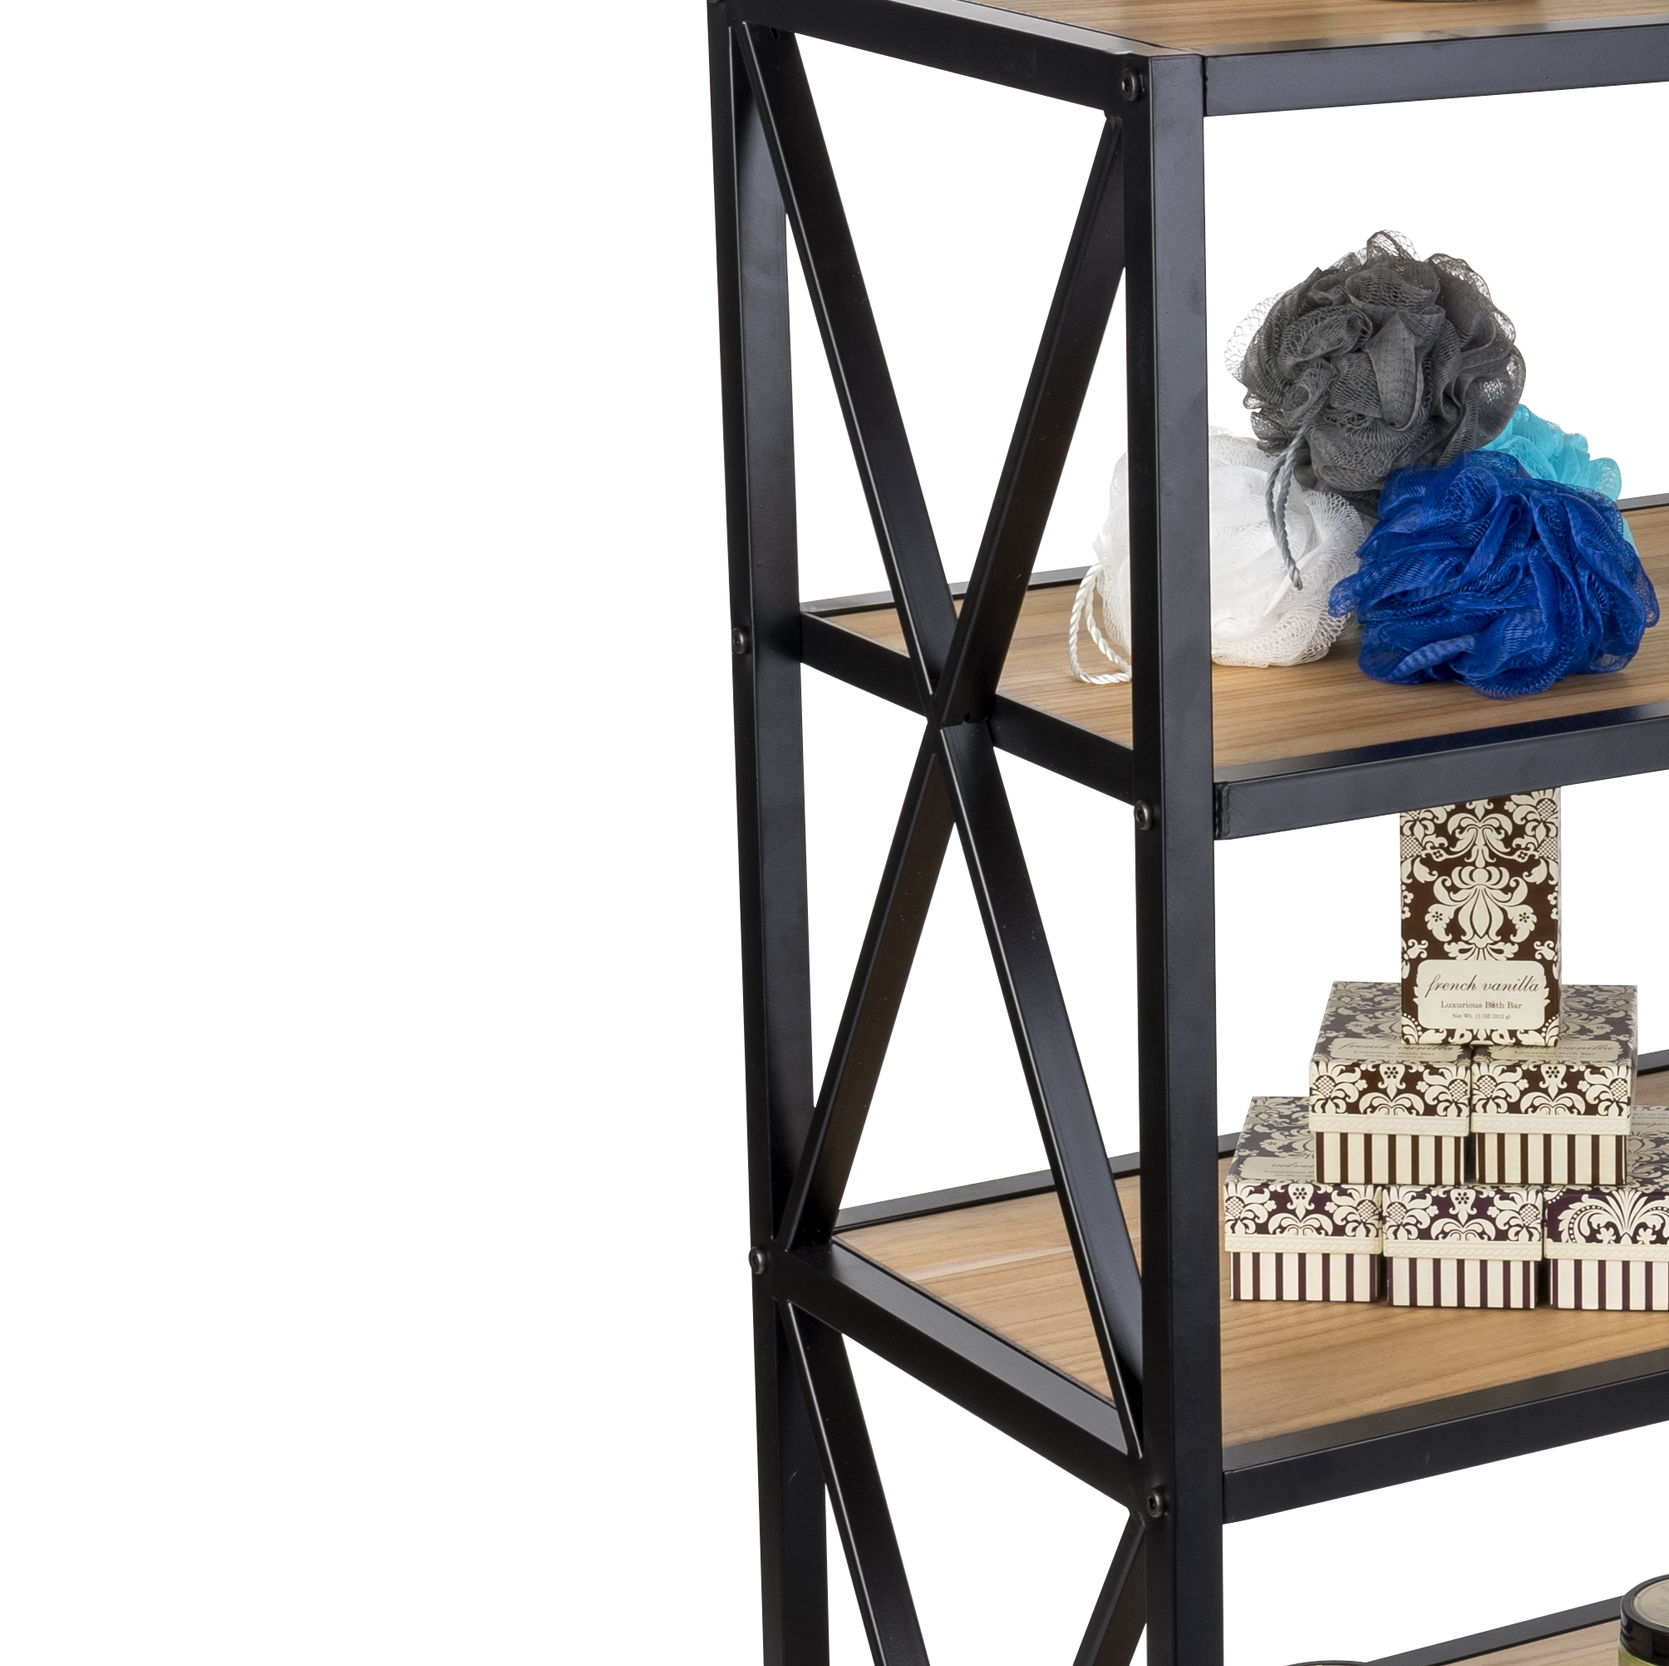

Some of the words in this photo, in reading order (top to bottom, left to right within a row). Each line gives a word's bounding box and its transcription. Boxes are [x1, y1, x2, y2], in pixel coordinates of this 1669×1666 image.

[1425, 974, 1478, 998] french
[1482, 975, 1540, 992] vanilla
[1440, 1001, 1482, 1009] Luxurious
[1485, 1001, 1504, 1009] Bath
[1507, 1001, 1522, 1009] Bar
